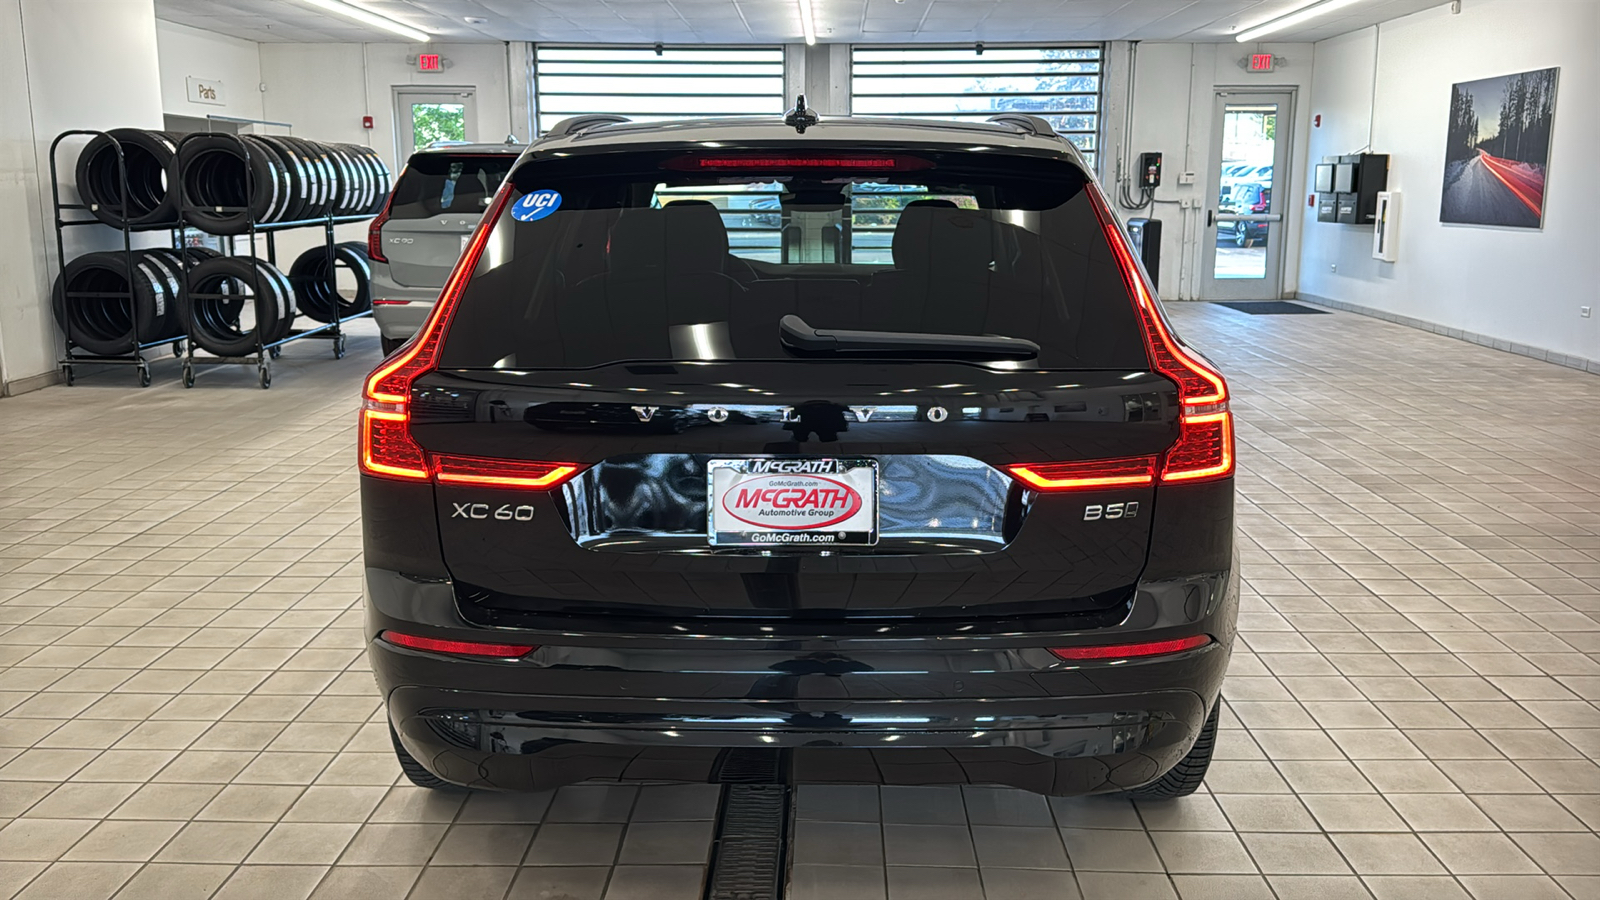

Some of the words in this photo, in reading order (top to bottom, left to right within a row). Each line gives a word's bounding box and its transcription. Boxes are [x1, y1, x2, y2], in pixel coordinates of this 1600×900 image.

[420, 54, 438, 69] EXIT
[1252, 54, 1271, 69] EXIT
[199, 84, 216, 100] Parts
[522, 193, 559, 208] UCI
[631, 405, 948, 423] VOLVO
[768, 480, 819, 488] GoMcGrath.com
[758, 508, 806, 517] Automotive
[807, 508, 835, 518] Group
[751, 532, 835, 543] GoMcGrath.com
